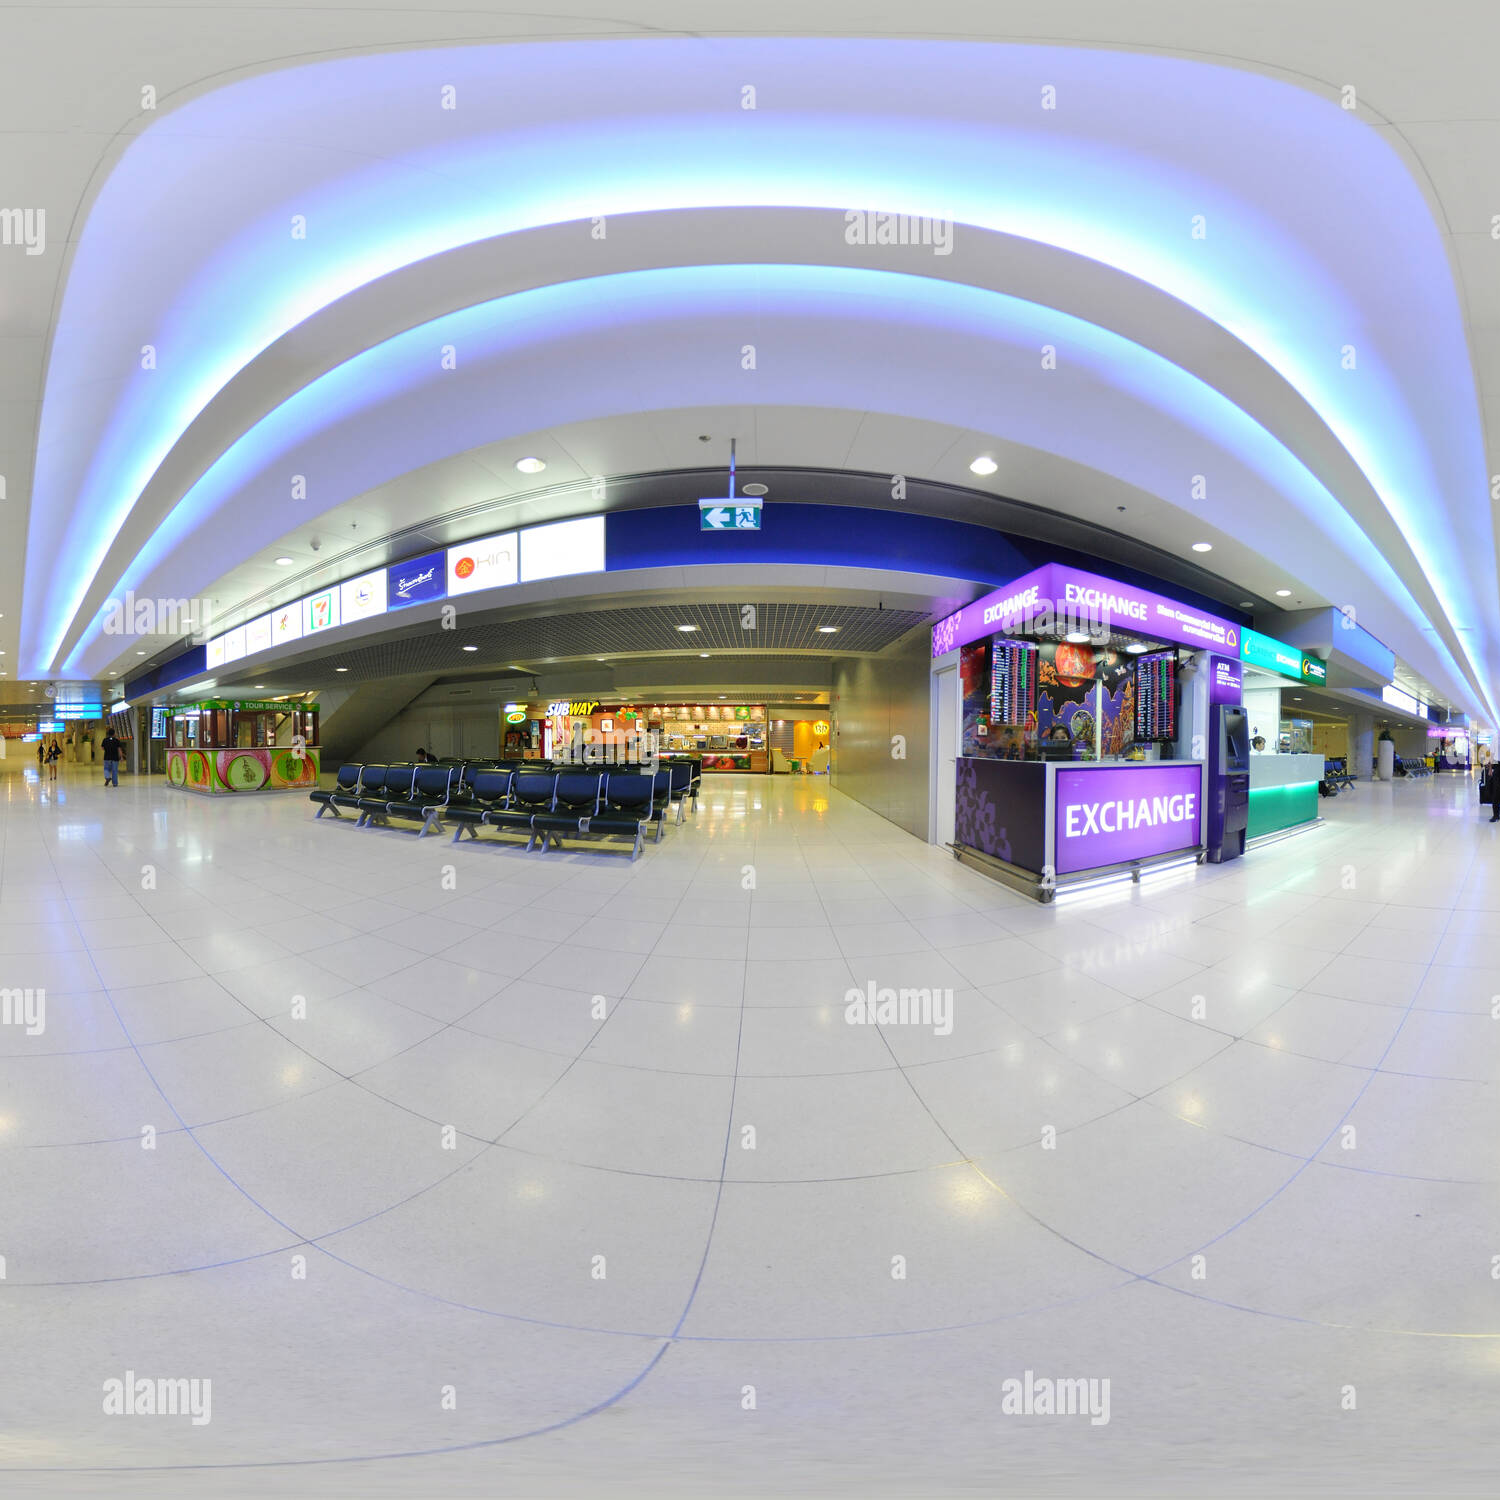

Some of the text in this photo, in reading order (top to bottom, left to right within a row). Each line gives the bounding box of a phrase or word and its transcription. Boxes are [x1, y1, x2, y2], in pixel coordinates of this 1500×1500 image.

[984, 585, 1039, 625] EXCHANGE
[1065, 583, 1148, 621] EXCHANGE
[1217, 662, 1230, 672] ATM
[245, 702, 293, 711] TOUR SERVICE
[545, 701, 600, 716] SUBWAY
[1066, 793, 1196, 838] EXCHANGE
